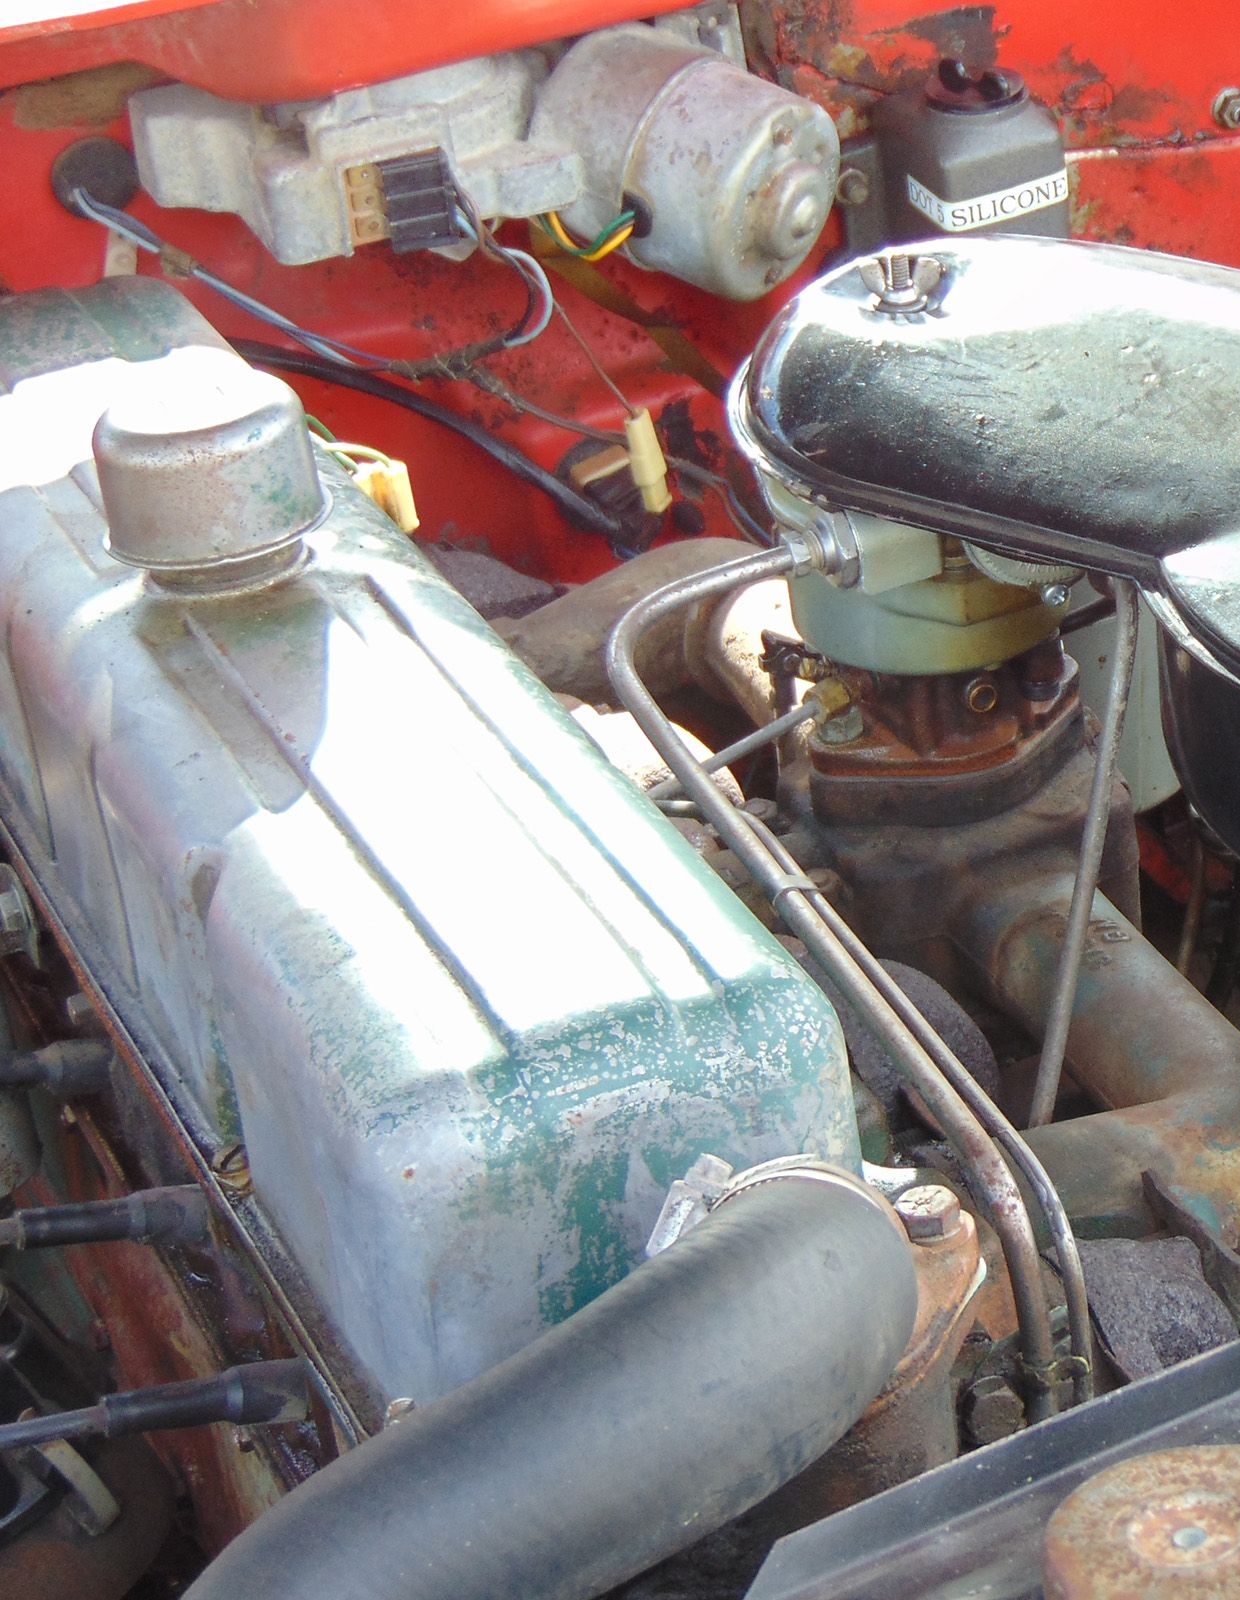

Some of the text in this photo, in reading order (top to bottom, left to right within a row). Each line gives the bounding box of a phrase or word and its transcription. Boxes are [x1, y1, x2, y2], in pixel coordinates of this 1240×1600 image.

[910, 177, 1067, 228] DOT 5 SILICONE
